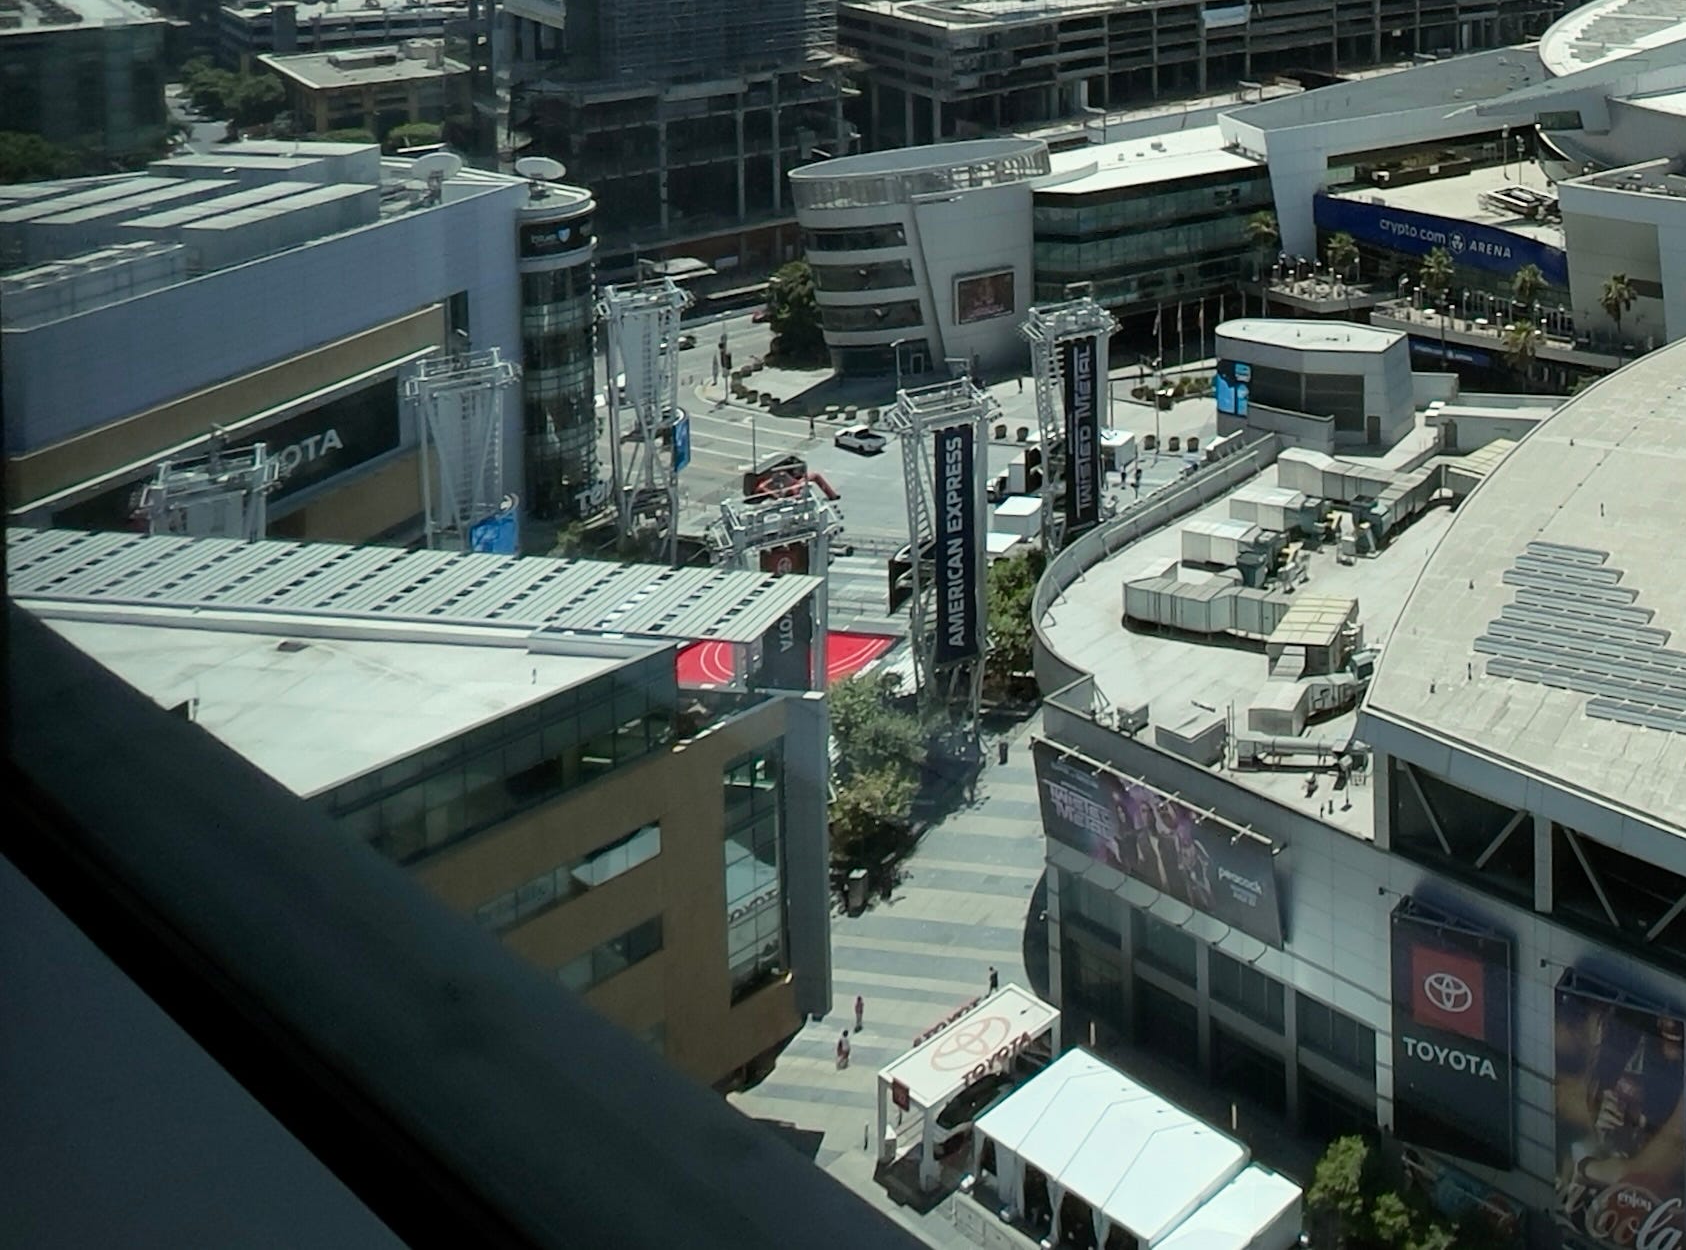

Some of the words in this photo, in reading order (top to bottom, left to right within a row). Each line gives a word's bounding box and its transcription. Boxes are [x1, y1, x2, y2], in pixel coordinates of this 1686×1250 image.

[1379, 217, 1447, 245] crypto.com
[1468, 240, 1513, 259] ARENA
[945, 436, 963, 534] EXPRESS
[946, 538, 966, 647] AMERICAN
[962, 1031, 1033, 1087] TOYOTA
[1402, 1036, 1498, 1081] TOYOTA
